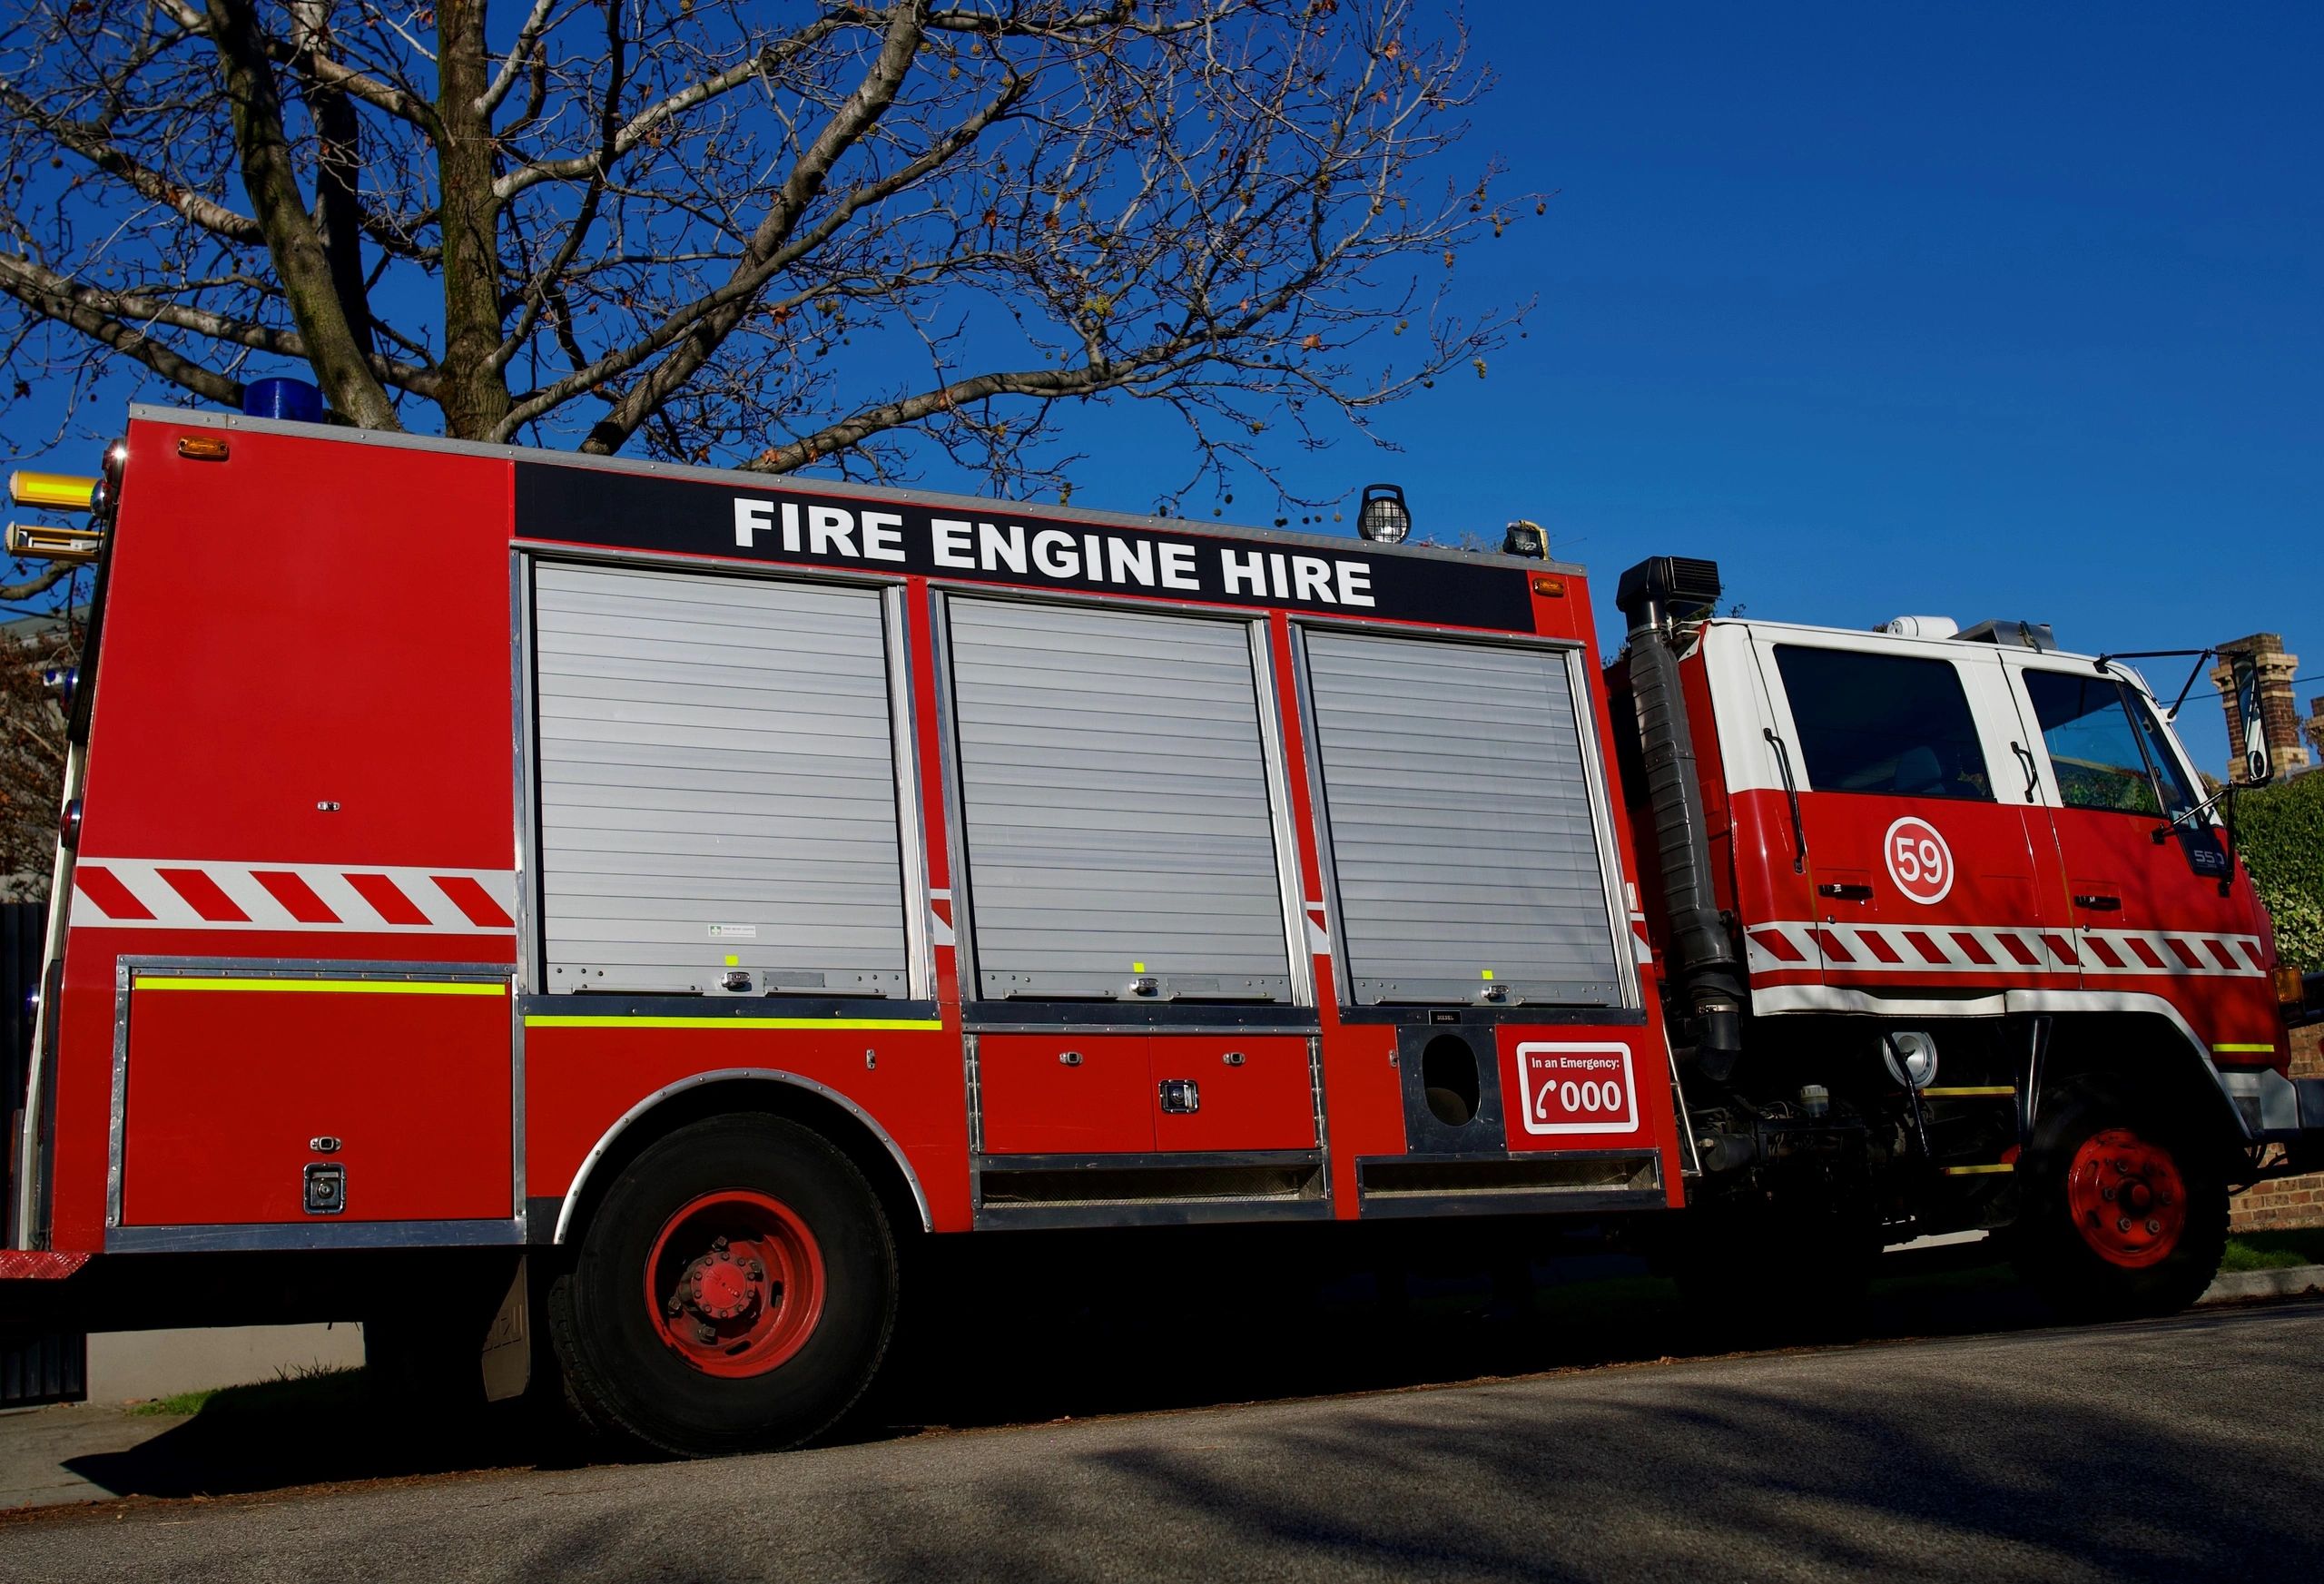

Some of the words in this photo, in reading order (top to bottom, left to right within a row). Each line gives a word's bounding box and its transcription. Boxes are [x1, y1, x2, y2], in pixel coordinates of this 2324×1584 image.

[734, 497, 906, 563] FIRE
[931, 518, 1200, 591] ENGINE
[1220, 548, 1375, 607] HIRE
[1896, 836, 1943, 884] 59
[1531, 1058, 1542, 1068] In
[1544, 1059, 1558, 1068] an
[1560, 1058, 1620, 1070] Emergency:
[1560, 1080, 1621, 1112] 000
